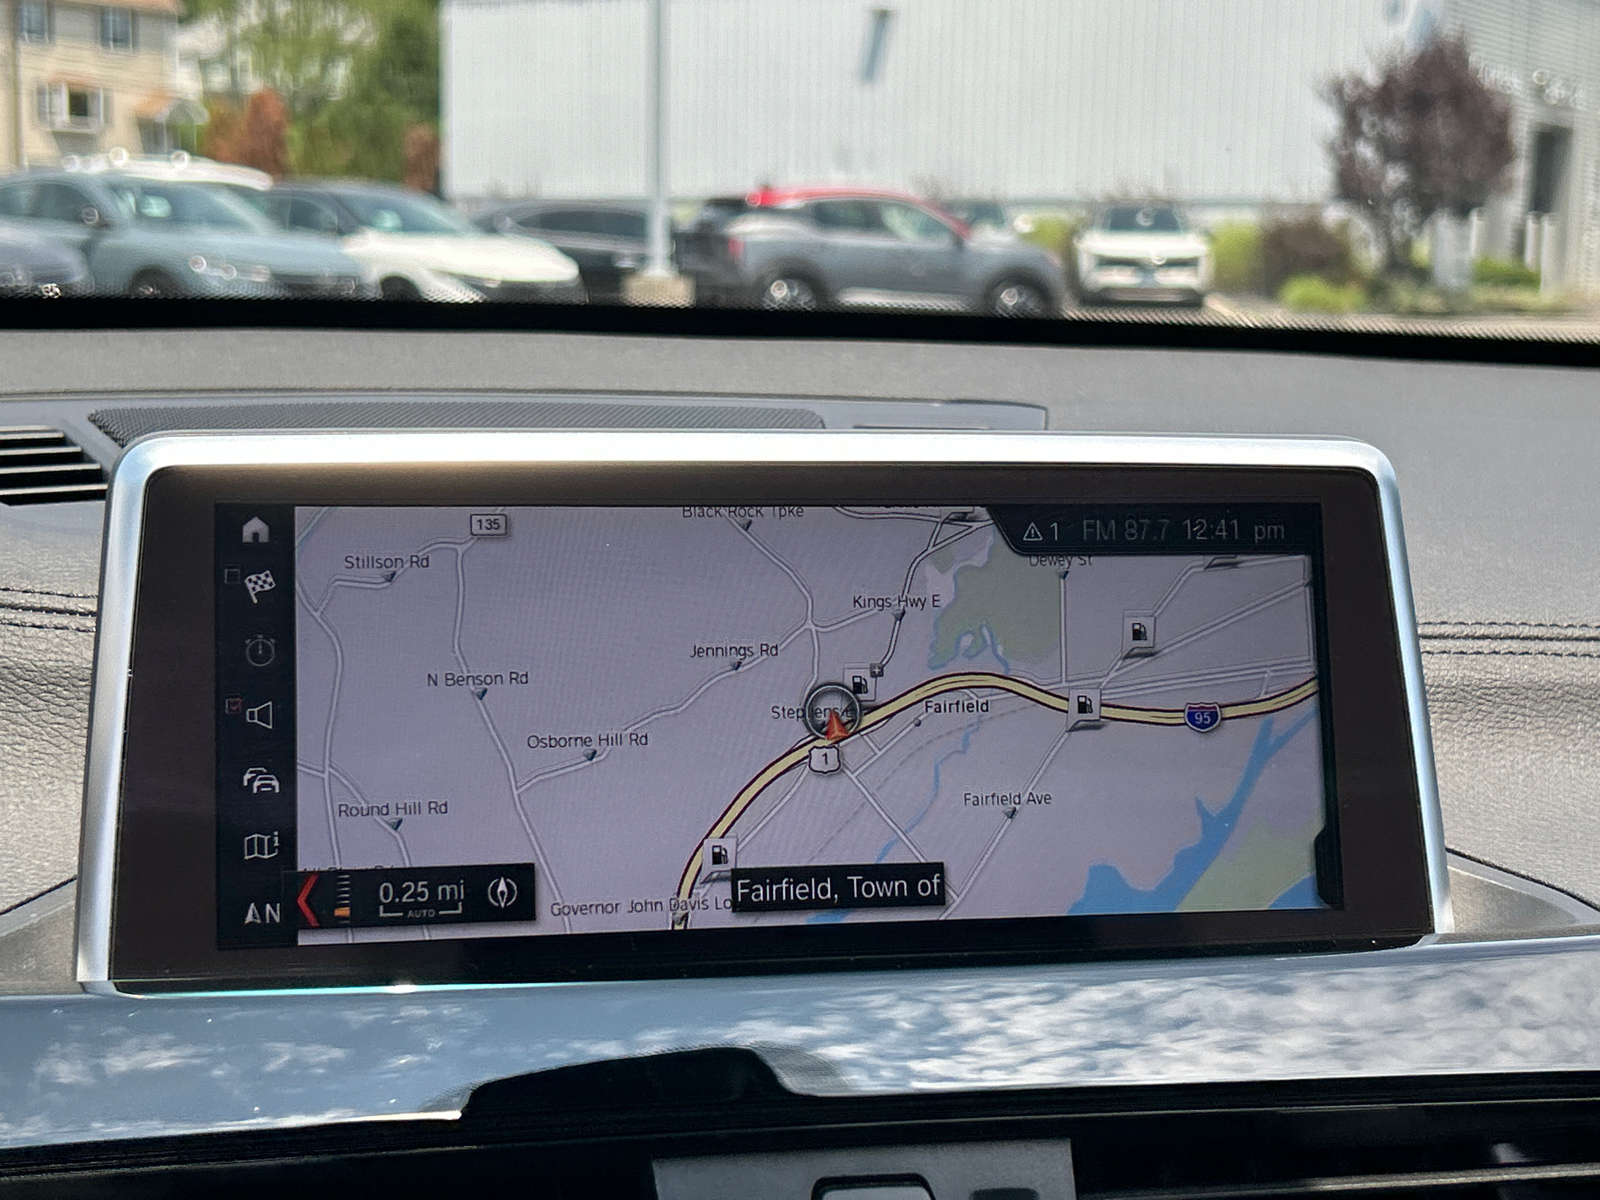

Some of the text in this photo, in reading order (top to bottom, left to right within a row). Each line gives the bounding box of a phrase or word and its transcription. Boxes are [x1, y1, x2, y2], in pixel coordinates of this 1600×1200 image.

[682, 507, 722, 518] Black
[728, 507, 764, 518] Rock
[477, 518, 500, 531] 135
[1050, 522, 1059, 541] 1
[1082, 519, 1170, 541] FM 87.7
[1182, 519, 1285, 543] 12:41 pm
[344, 554, 430, 569] Stillson Rd
[1029, 556, 1093, 568] Dewey St
[853, 594, 941, 611] Kings Hwy E
[690, 643, 779, 659] Jennings Rd
[427, 671, 529, 687] N Benson Rd
[924, 700, 990, 714] Fairfield
[1195, 711, 1211, 724] 95
[527, 731, 649, 749] Osborne Hill Rd
[821, 752, 828, 765] 1
[963, 791, 1052, 806] Fairfield Ave
[338, 800, 448, 817] Round Hill Rd
[379, 879, 465, 903] 0.25 mi
[737, 873, 941, 904] Fairfield, Town of
[407, 909, 435, 918] AUTO
[550, 902, 620, 917] Governor
[627, 899, 663, 914] John
[669, 896, 709, 912] Davis
